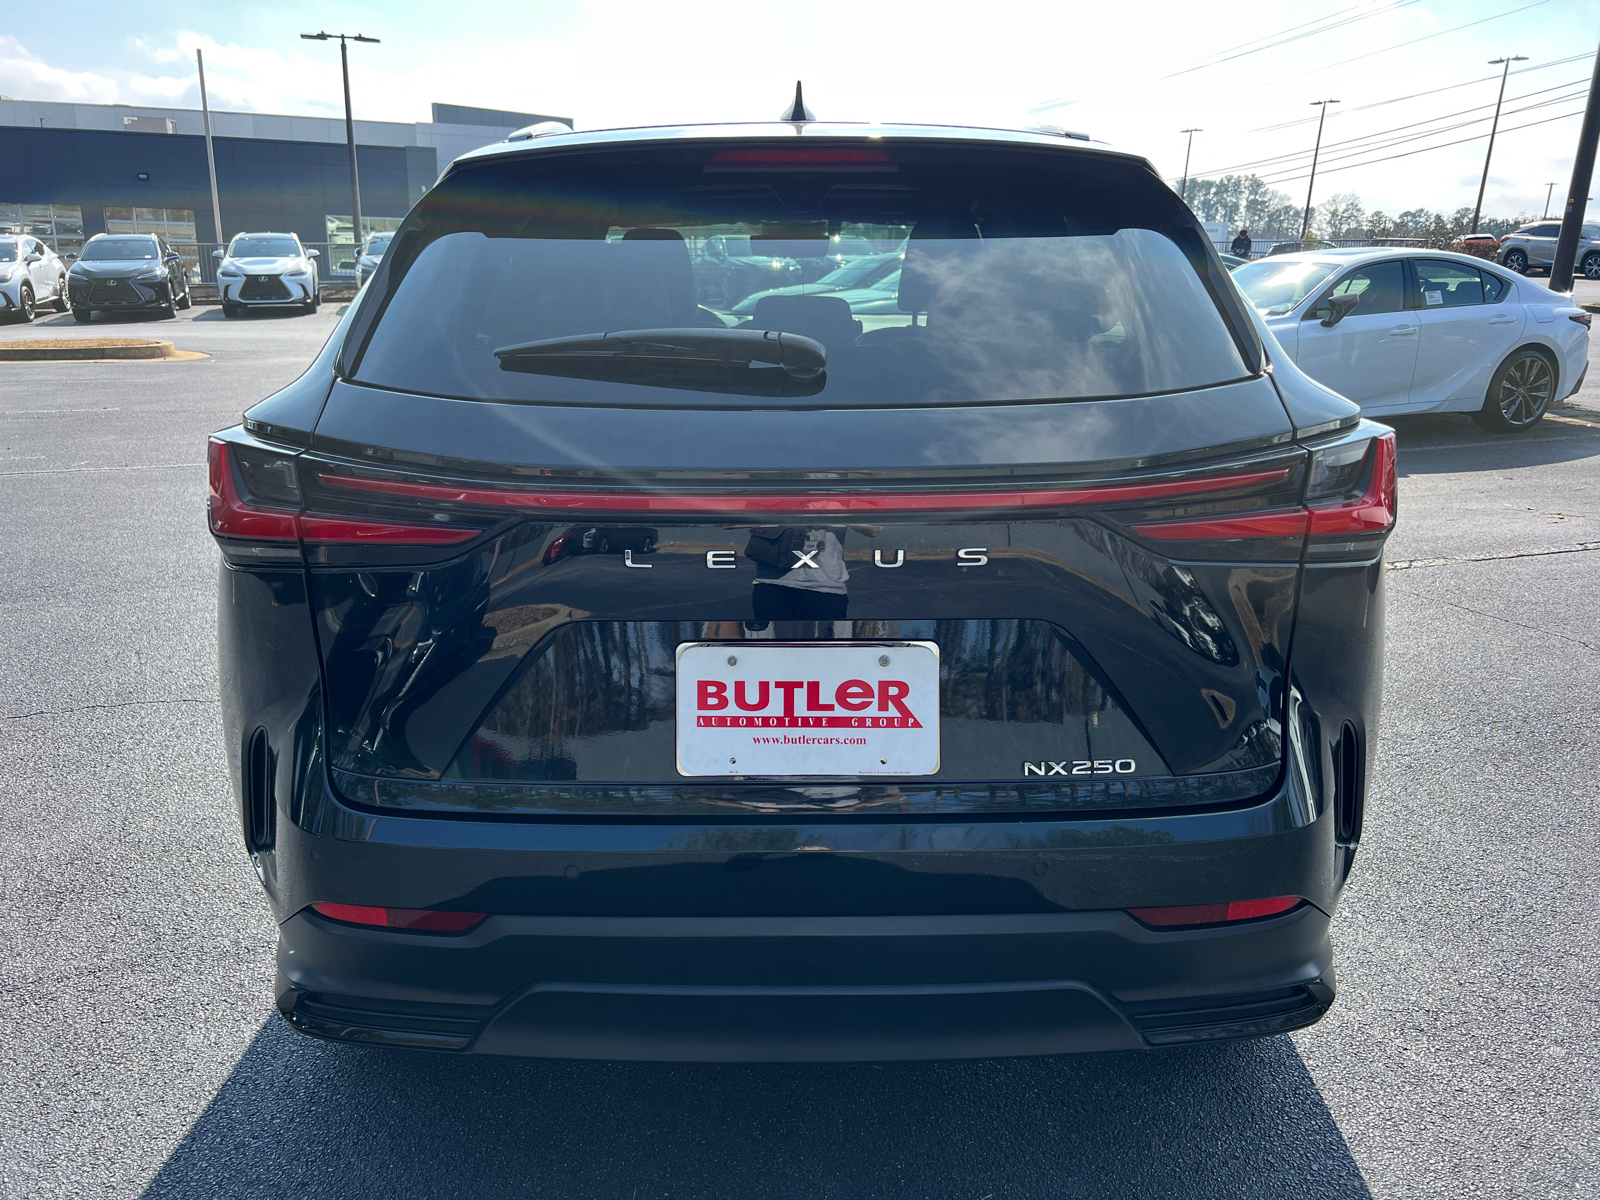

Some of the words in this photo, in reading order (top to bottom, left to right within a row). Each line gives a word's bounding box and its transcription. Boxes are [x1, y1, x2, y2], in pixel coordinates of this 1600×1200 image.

[624, 547, 989, 569] LEXUS
[698, 717, 829, 727] AUTOMOTIVE
[851, 717, 915, 727] GROUP
[752, 734, 867, 745] www.butlercars.com
[1023, 758, 1137, 777] NX250
